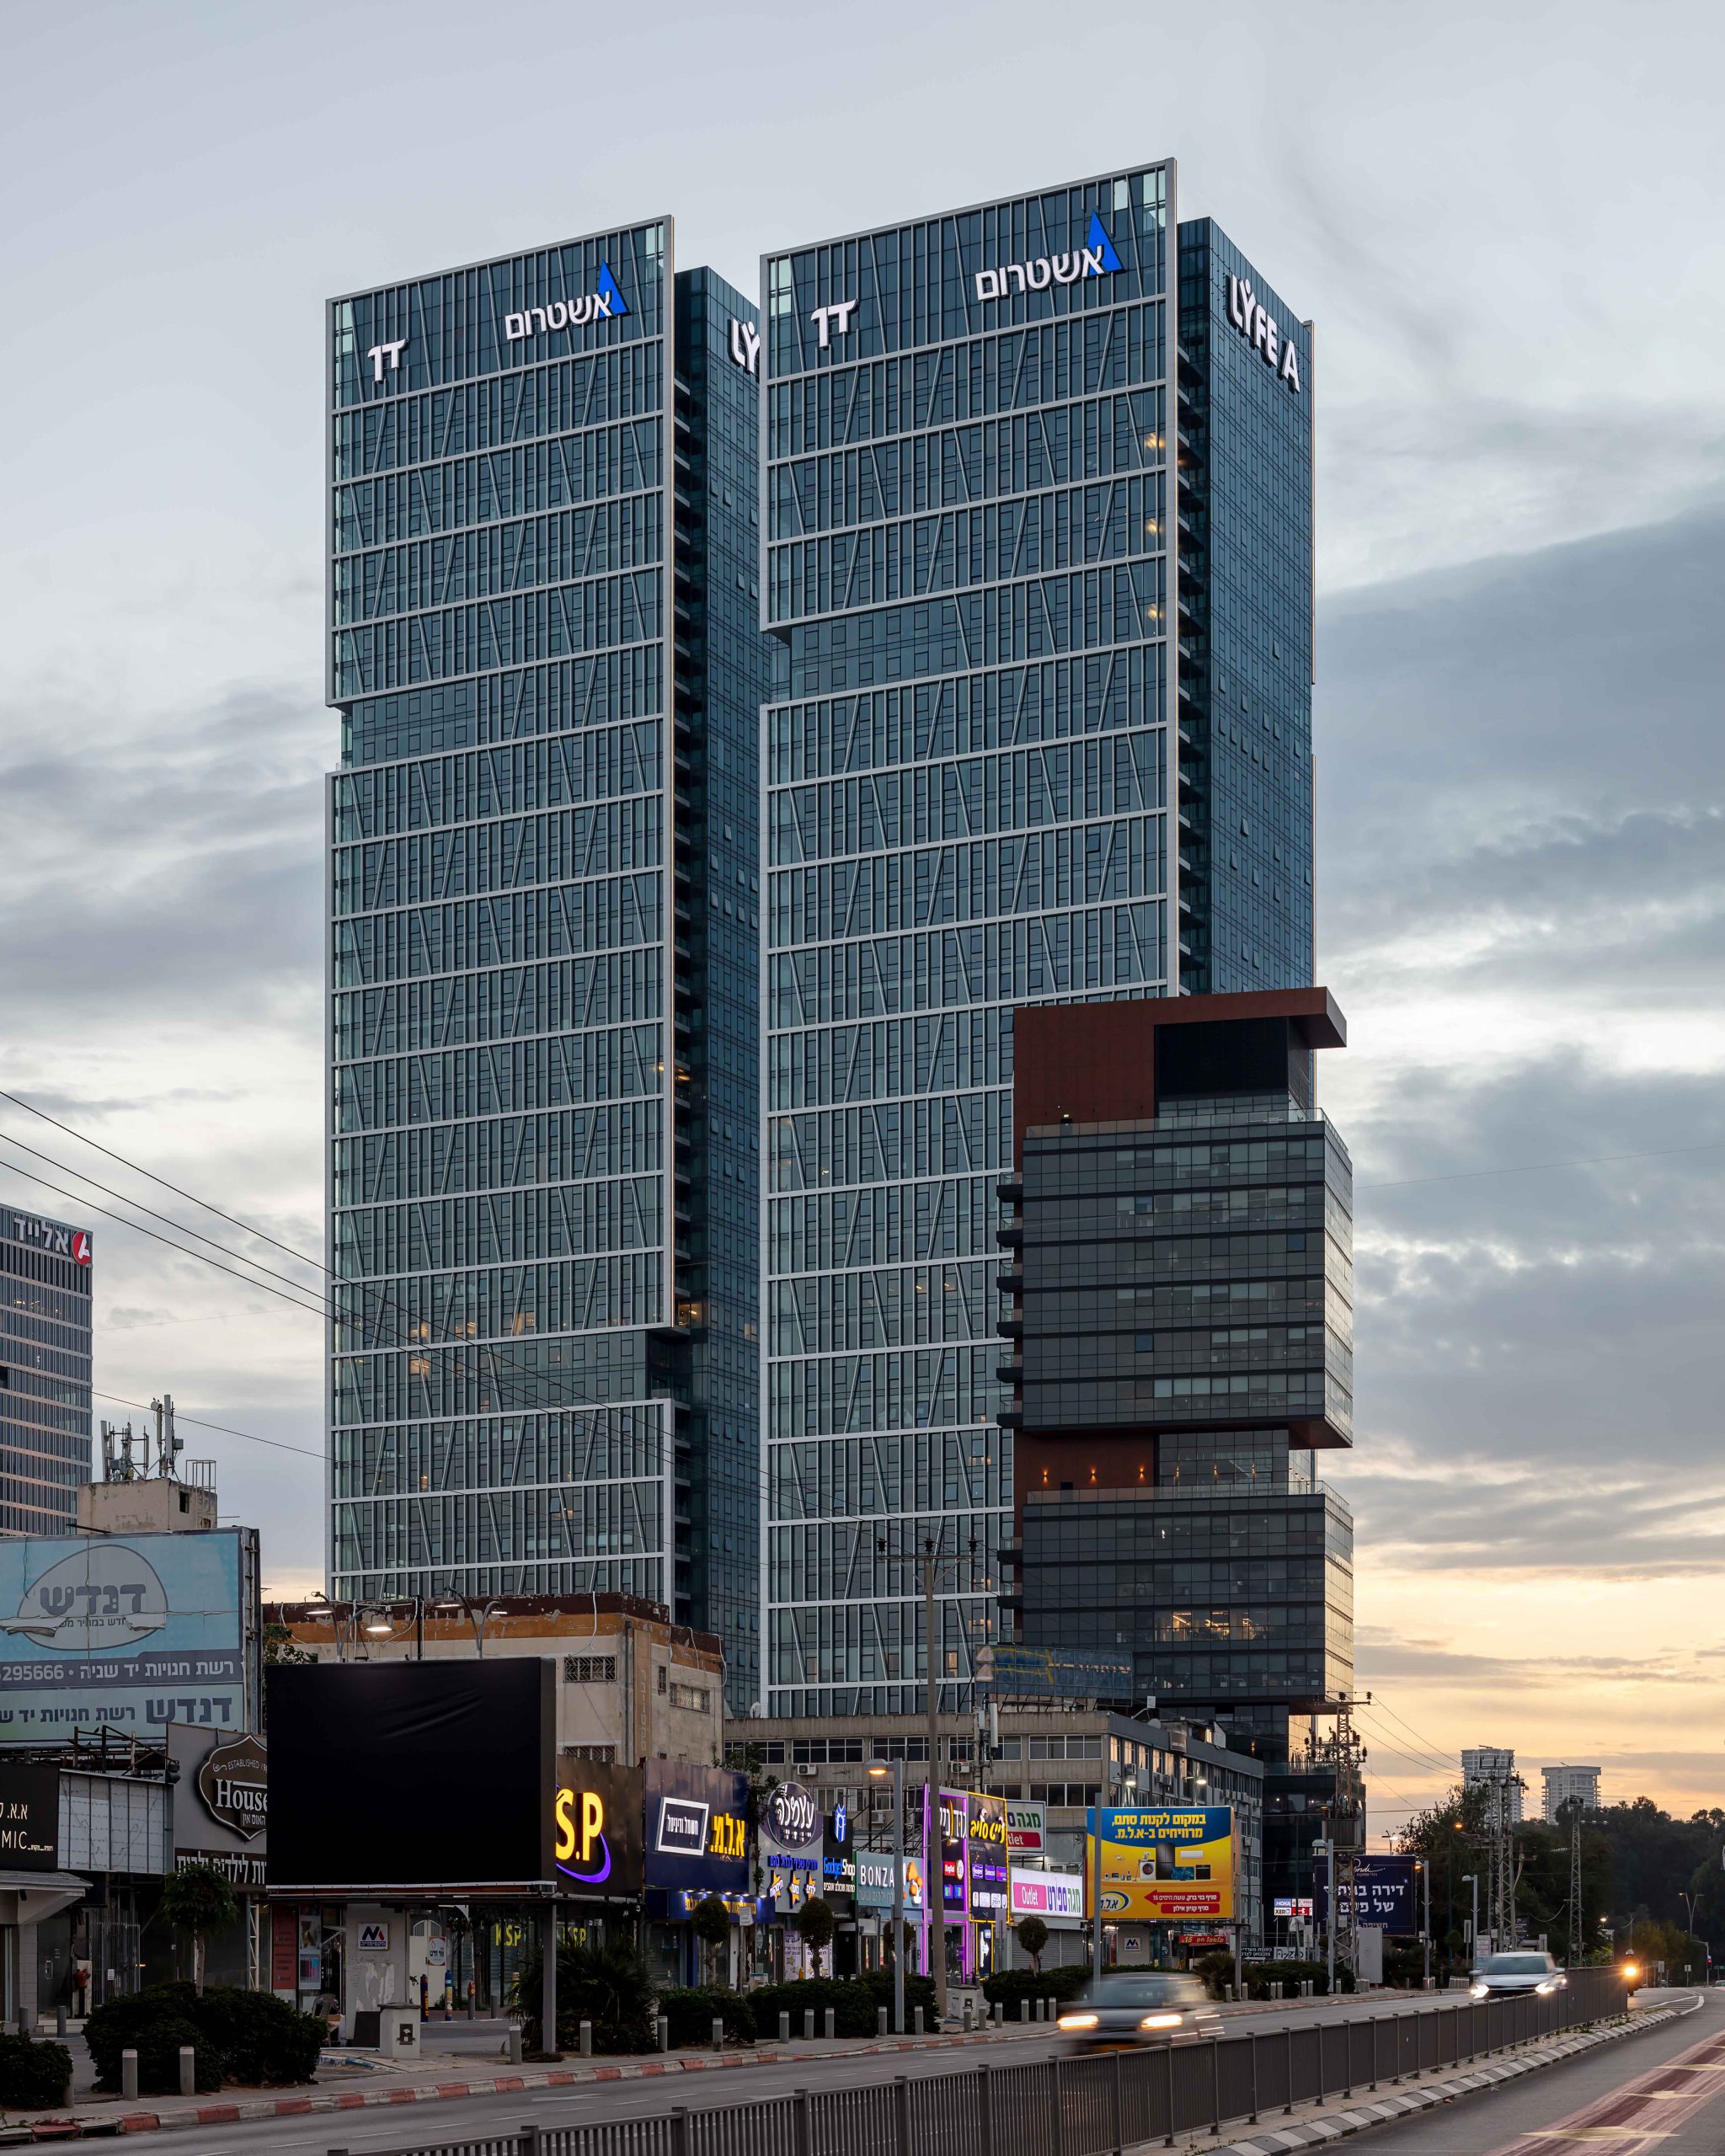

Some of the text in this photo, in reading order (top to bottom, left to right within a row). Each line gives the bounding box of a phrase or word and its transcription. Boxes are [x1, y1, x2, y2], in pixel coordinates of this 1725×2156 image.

[975, 245, 1105, 301] אשטרום
[505, 290, 612, 340] אשטרום
[1230, 274, 1300, 392] LYFE A
[731, 318, 760, 375] LY
[13, 1218, 68, 1254] אלייד
[40, 1584, 146, 1615] דנדש
[2, 1665, 64, 1681] 295666
[80, 1661, 234, 1680] רשת חנויות יד שניה
[19, 1710, 35, 1723] יד
[40, 1708, 89, 1723] חנויות
[96, 1706, 136, 1722] רשת
[146, 1697, 232, 1724] דנדש
[228, 1759, 259, 1770] ESTABLISHED
[556, 1789, 603, 1861] S.P
[1017, 1812, 1042, 1829] מגה
[1140, 1812, 1170, 1828] לקנות
[1172, 1814, 1206, 1828] במקום
[2, 1830, 28, 1849] MIC
[1008, 1833, 1025, 1846] tlet
[1158, 1828, 1203, 1838] מרוויחים
[860, 1865, 895, 1888] BONZA
[1022, 1886, 1039, 1906] Outlet
[1371, 1885, 1405, 1897] דירה
[1373, 1898, 1395, 1913] של
